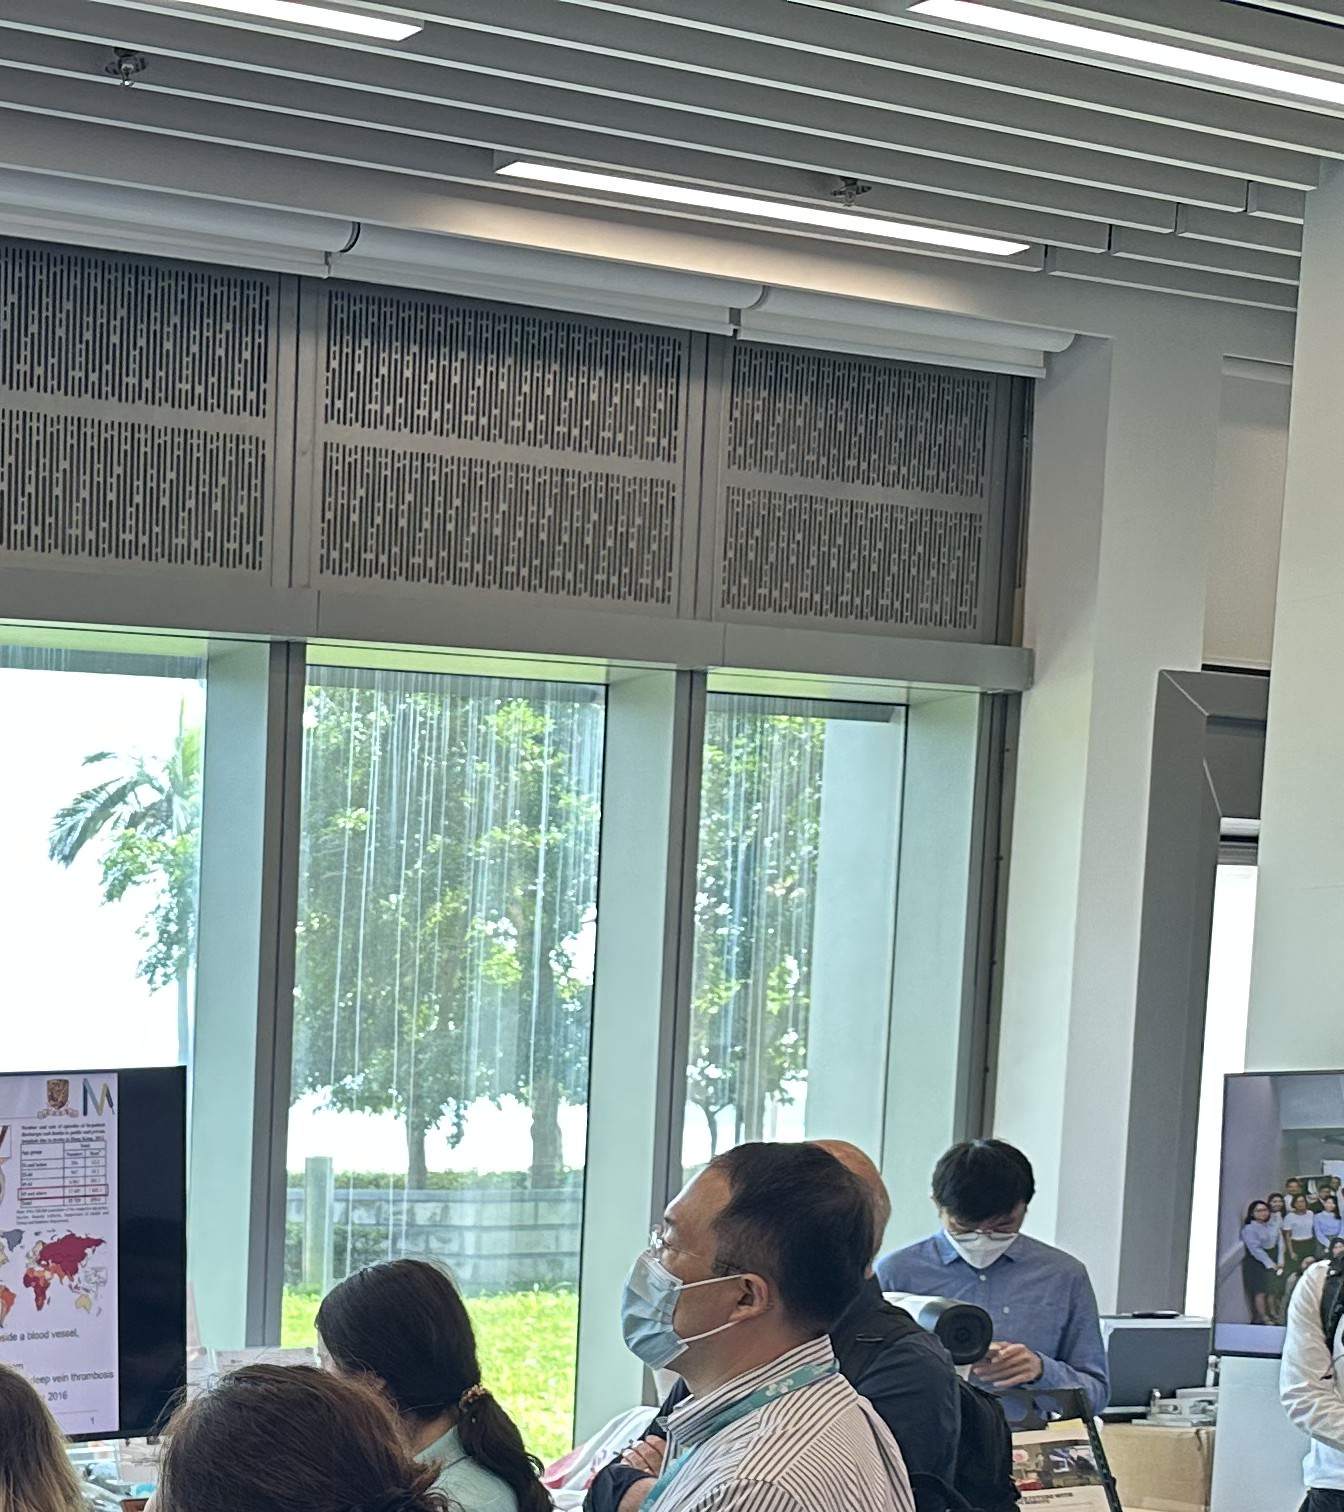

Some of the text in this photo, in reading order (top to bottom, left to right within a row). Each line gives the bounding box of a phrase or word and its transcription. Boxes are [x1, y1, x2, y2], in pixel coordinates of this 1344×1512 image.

[19, 1333, 26, 1341] a
[27, 1330, 49, 1340] blood
[52, 1373, 69, 1382] vein
[71, 1371, 114, 1381] thrombosis
[48, 1391, 68, 1401] 2016
